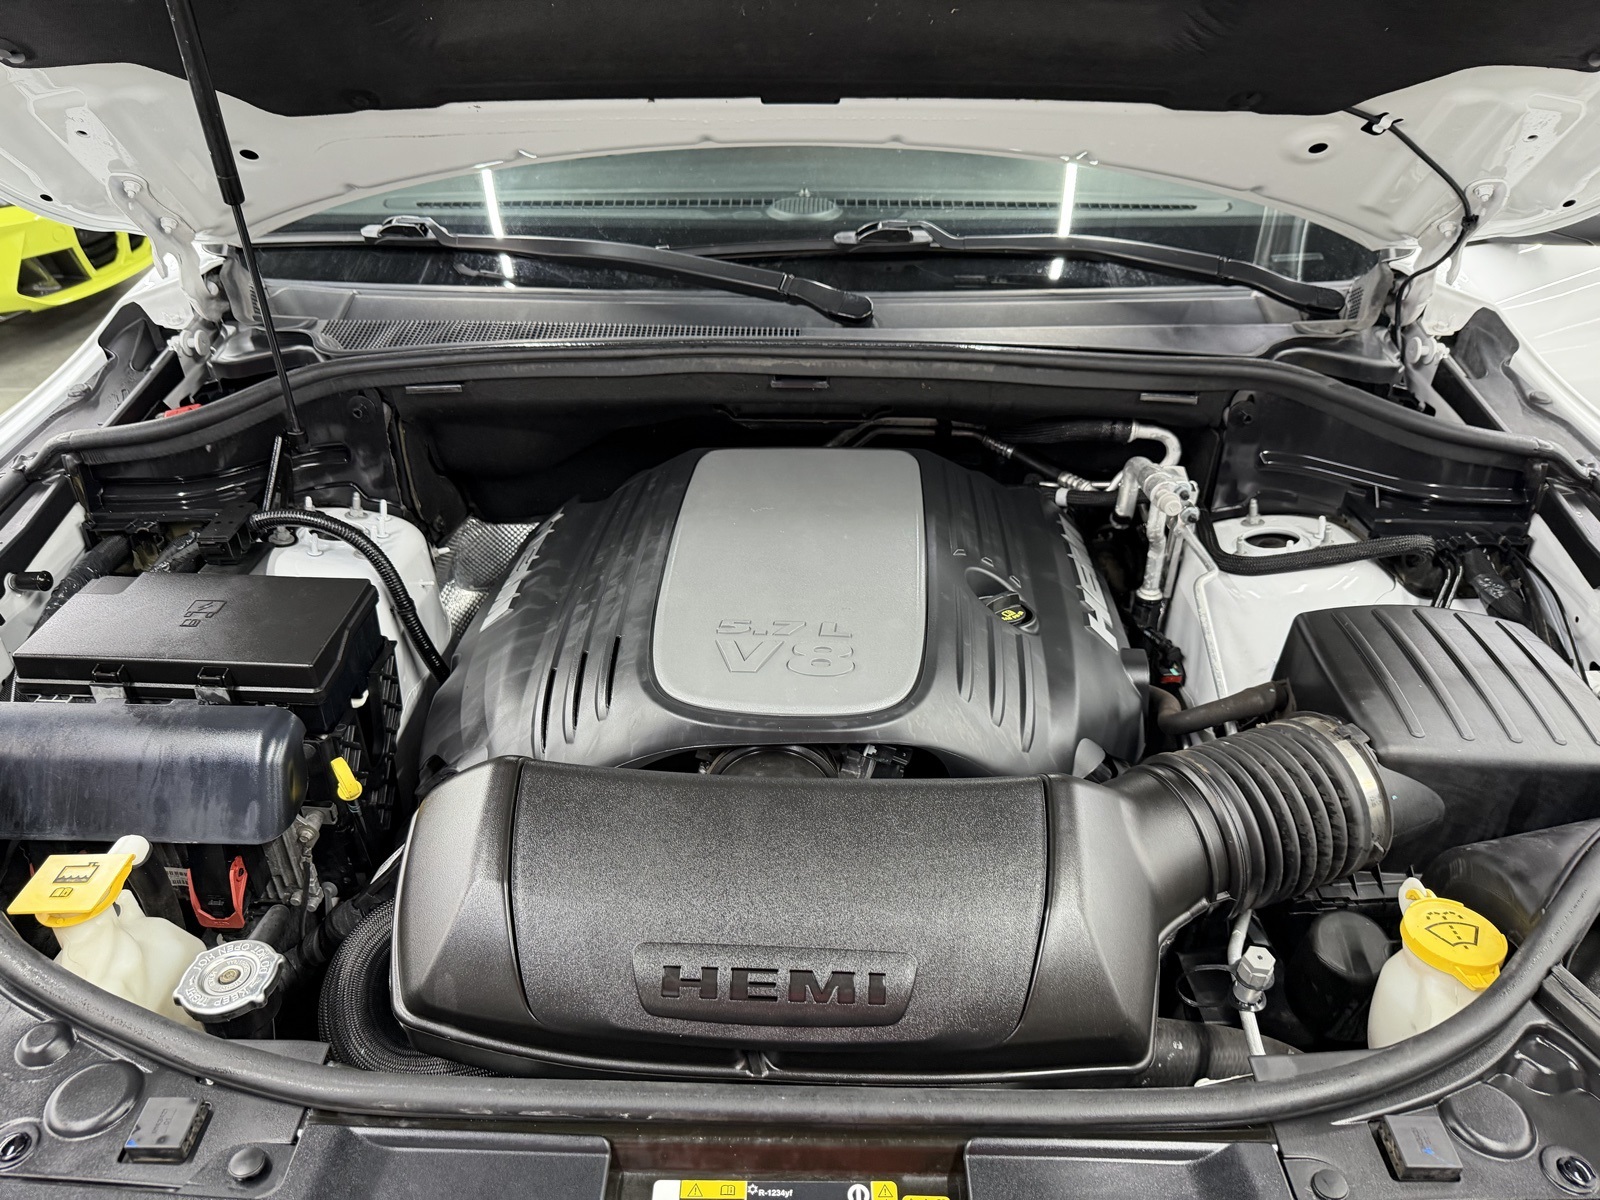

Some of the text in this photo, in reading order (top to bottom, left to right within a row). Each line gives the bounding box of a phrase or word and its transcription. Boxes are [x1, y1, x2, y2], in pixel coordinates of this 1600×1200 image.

[716, 619, 806, 636] 5.7
[715, 640, 856, 677] V8
[218, 943, 251, 956] OPEN
[251, 946, 269, 961] NOT
[194, 953, 216, 971] HOT
[661, 965, 886, 1006] HEMI
[186, 987, 250, 1007] KEEP TIGHT
[758, 1189, 793, 1198] R-1234yf
